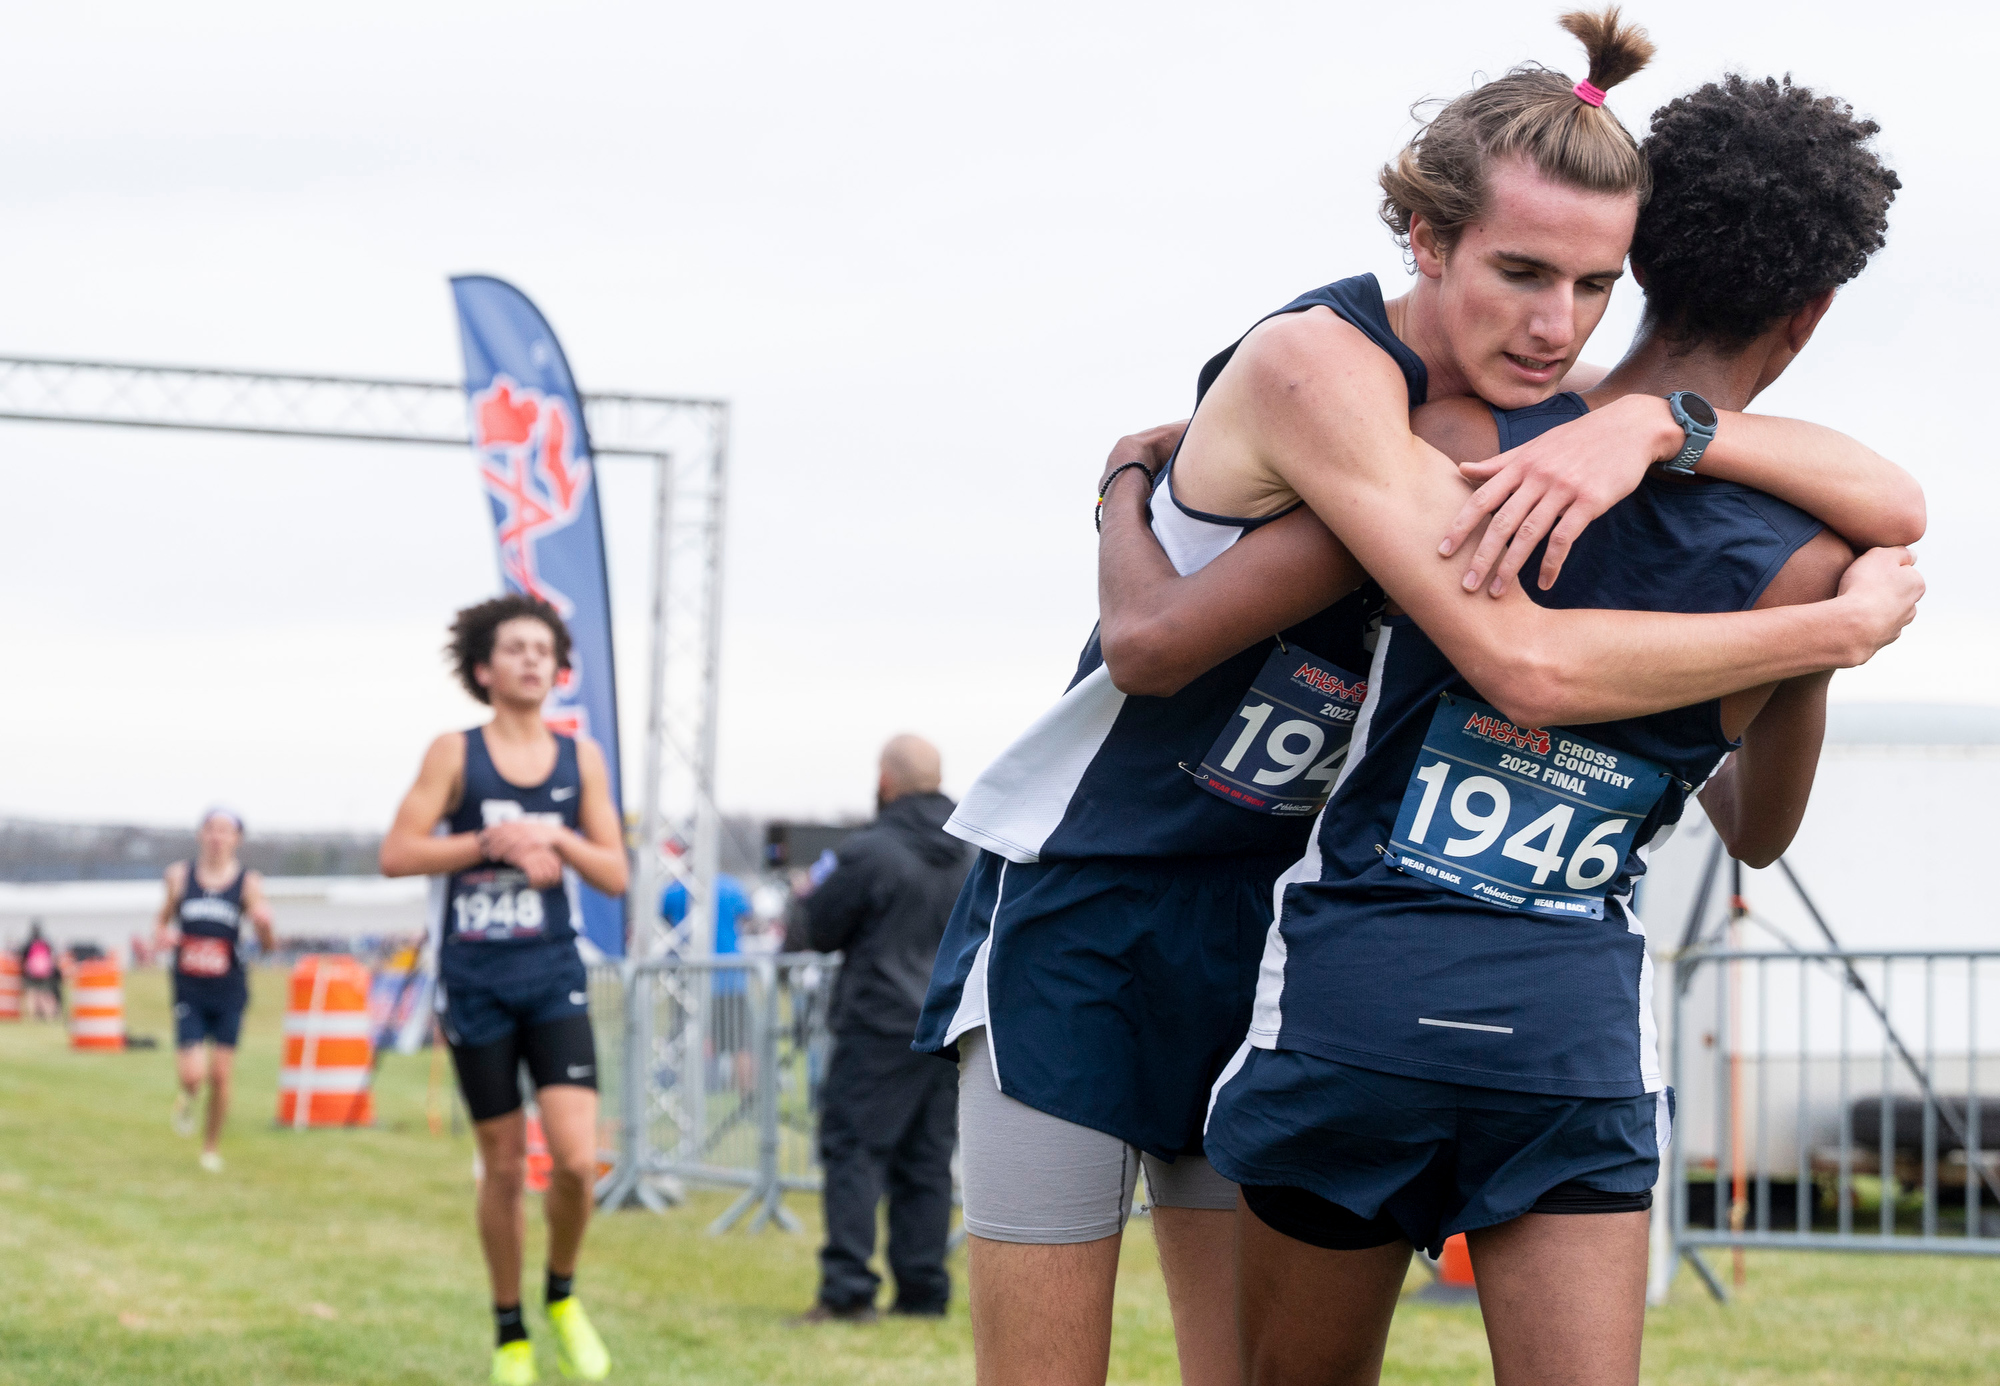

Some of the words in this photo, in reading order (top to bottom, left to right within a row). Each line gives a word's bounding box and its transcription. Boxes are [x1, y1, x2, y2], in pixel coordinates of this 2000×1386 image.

[1293, 662, 1358, 703] MHSAA
[1320, 703, 1356, 721] 2022
[1220, 702, 1350, 794] 194
[1464, 712, 1538, 752] MHSAA
[1553, 753, 1635, 789] COUNTRY
[1558, 740, 1618, 769] CROSS
[1208, 779, 1231, 794] WEAR
[1230, 790, 1242, 799] ON
[1242, 794, 1266, 807] FRONT
[1498, 754, 1541, 779] 2022
[1542, 767, 1587, 796] FINAL
[1408, 761, 1628, 890] 1946
[1401, 856, 1426, 871] WEAR
[1425, 865, 1439, 876] ON
[1438, 870, 1462, 885] BACK
[453, 889, 544, 932] 1948
[1534, 898, 1554, 908] WEAR
[1554, 899, 1566, 909] ON
[1566, 901, 1587, 913] BACK
